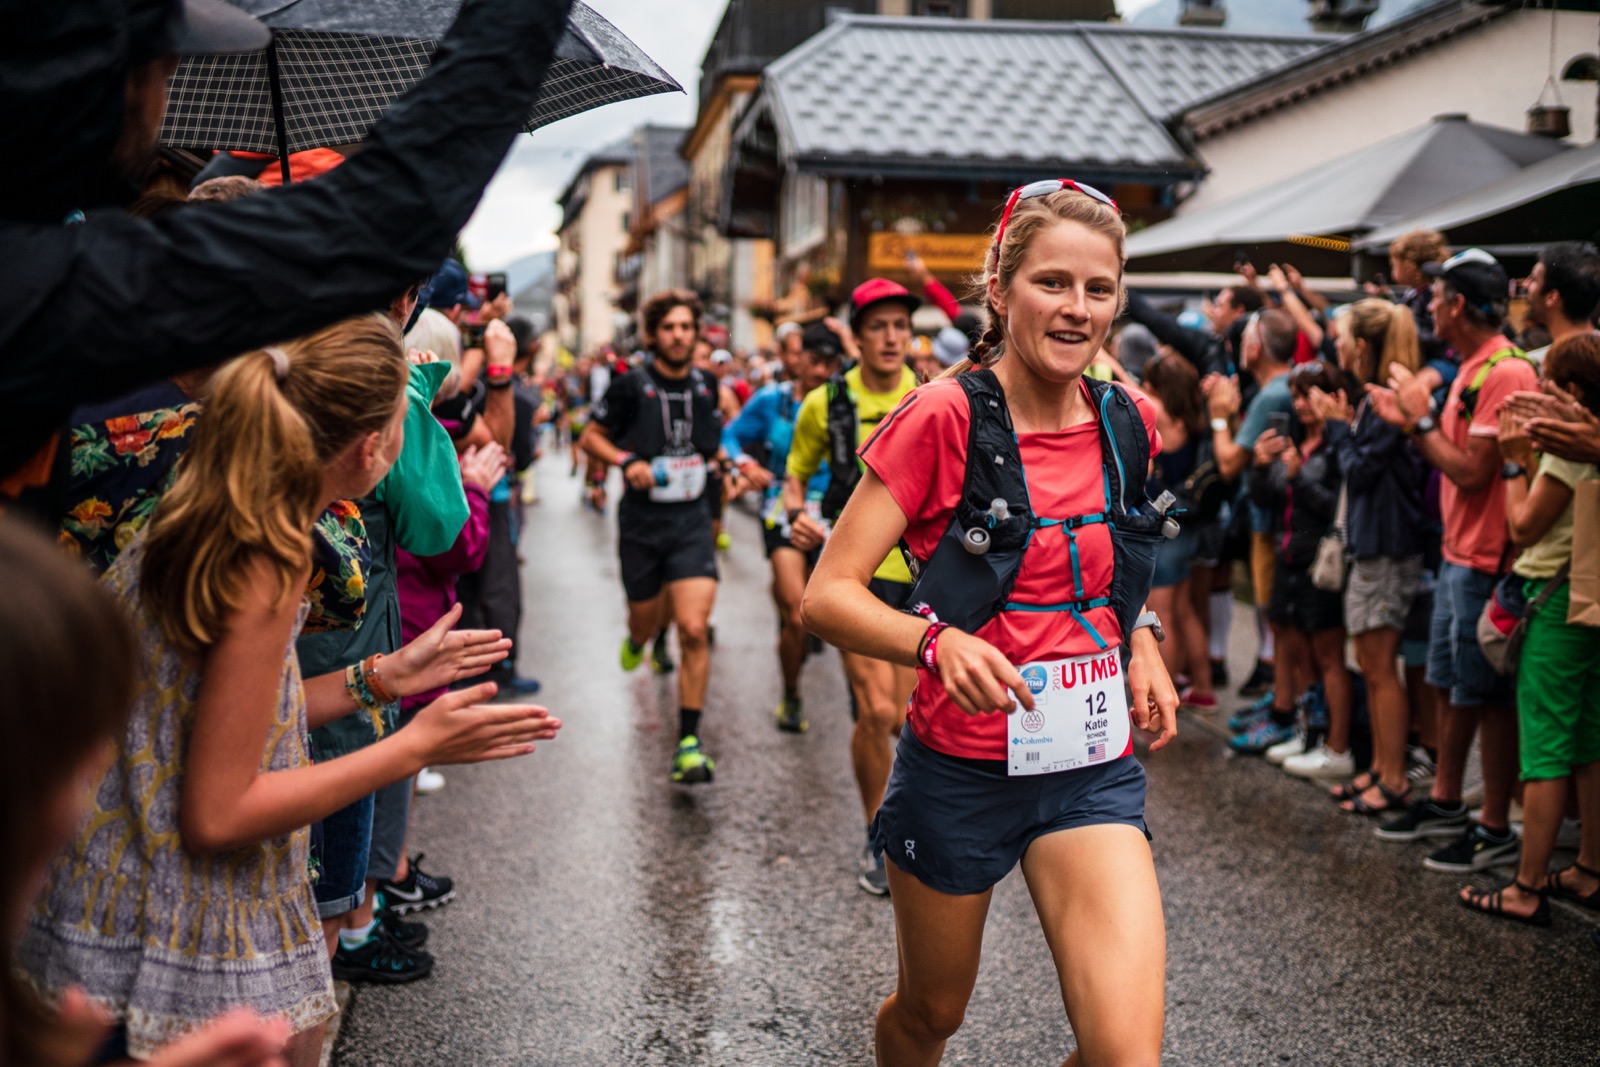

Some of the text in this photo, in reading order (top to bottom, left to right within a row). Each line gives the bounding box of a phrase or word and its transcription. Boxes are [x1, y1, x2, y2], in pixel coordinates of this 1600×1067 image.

[1052, 665, 1060, 691] 2019
[1061, 654, 1118, 689] UTMB
[1085, 690, 1107, 716] 12
[1085, 717, 1108, 731] Katie
[1020, 736, 1053, 745] Columbia
